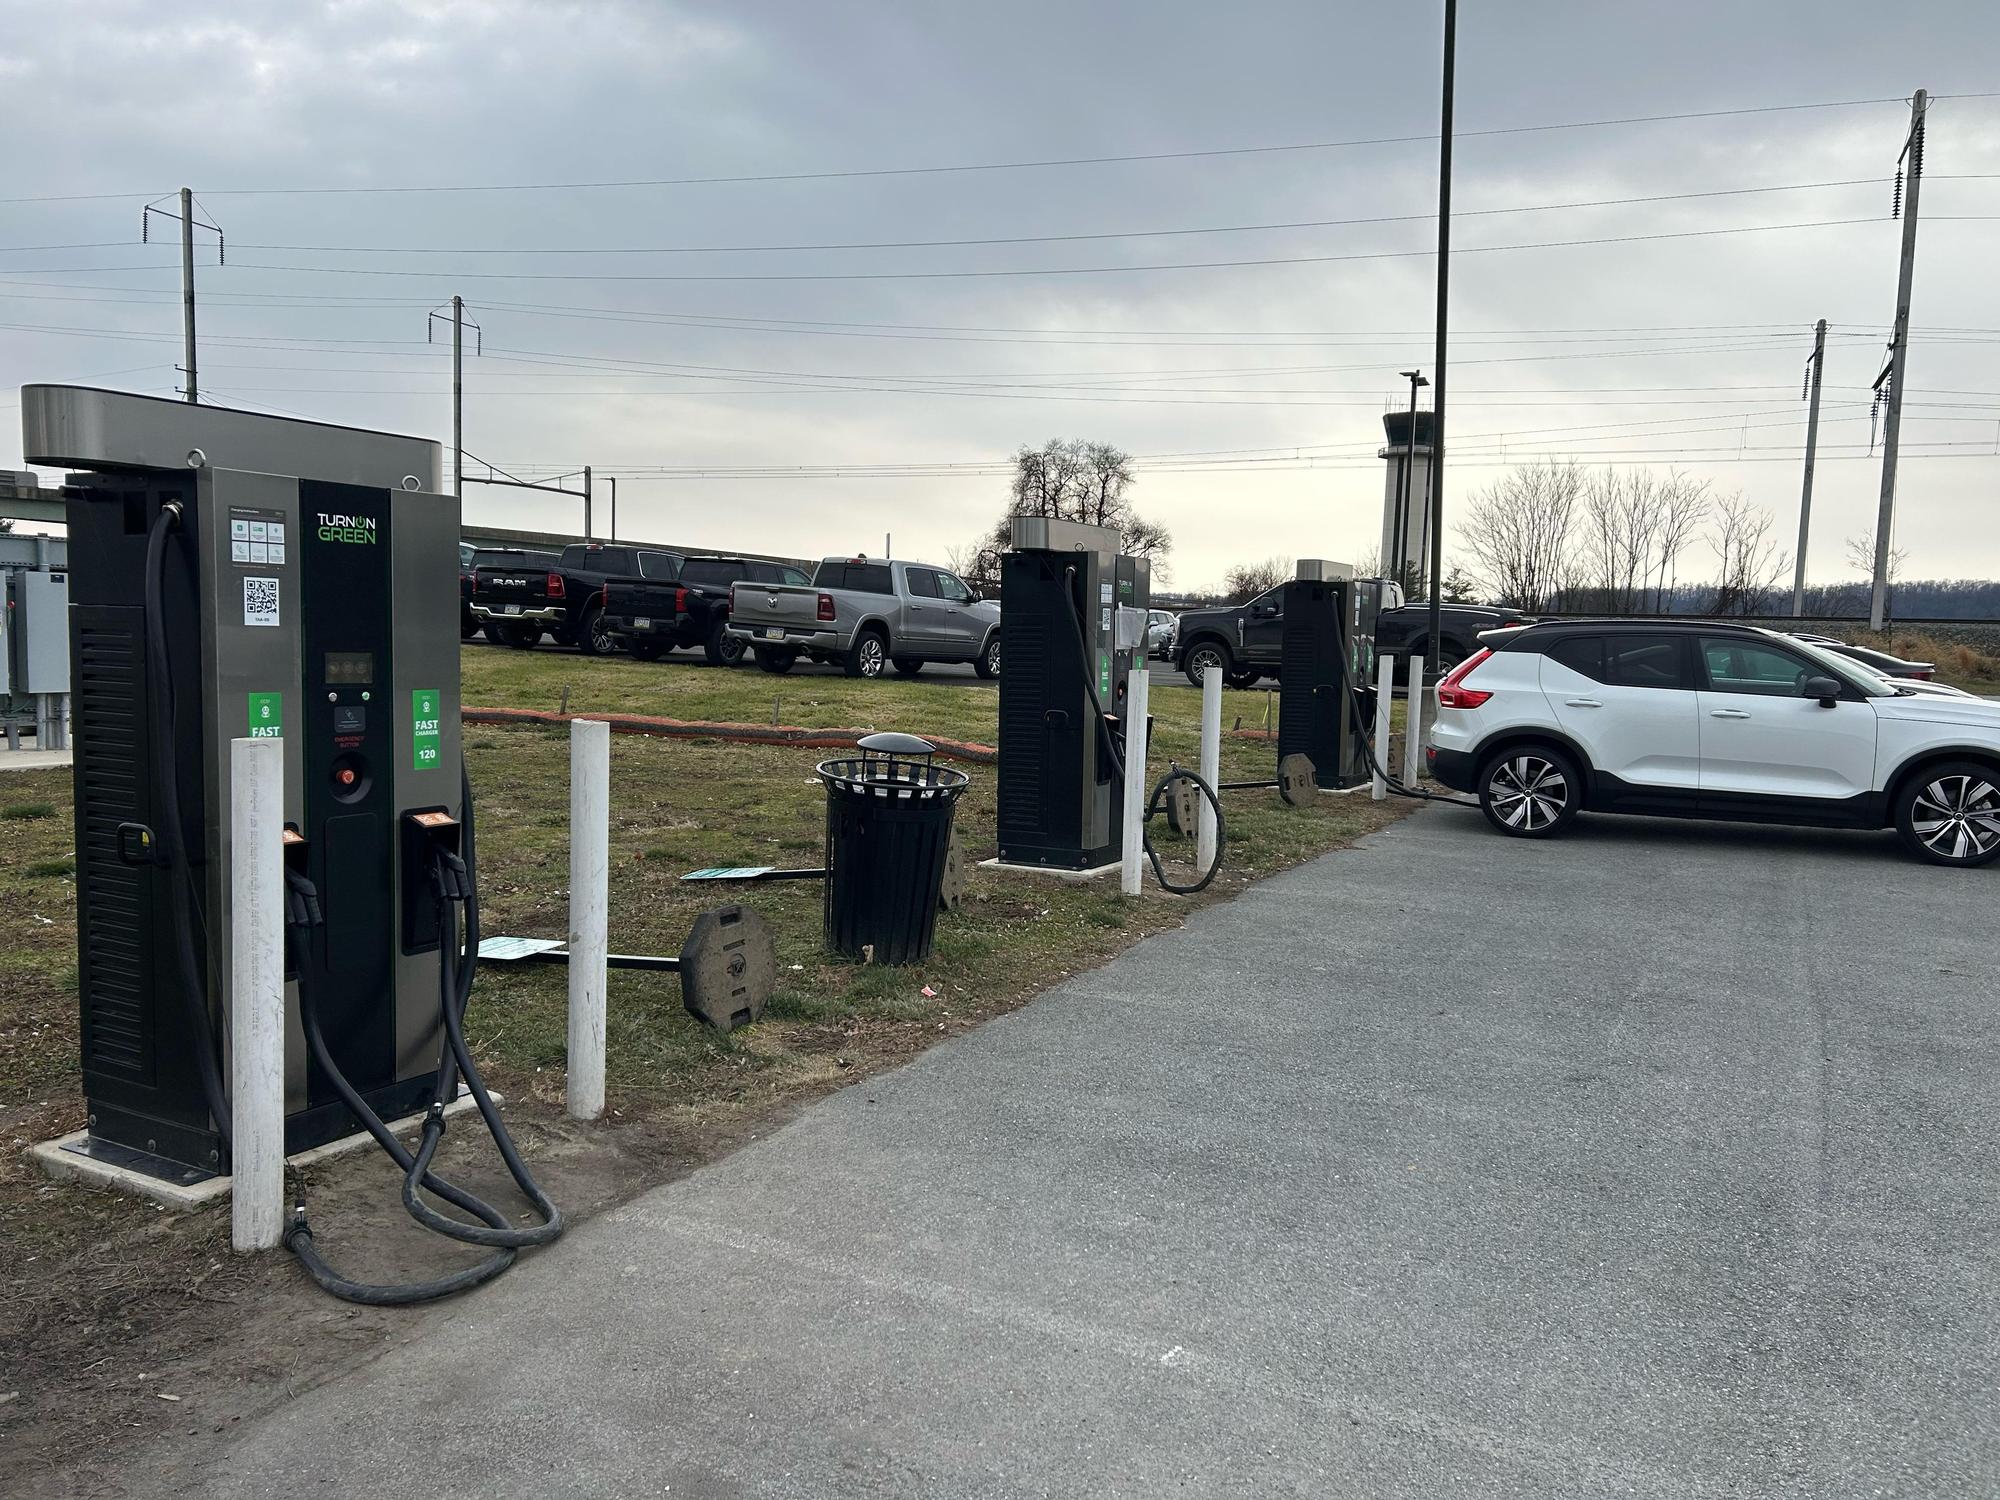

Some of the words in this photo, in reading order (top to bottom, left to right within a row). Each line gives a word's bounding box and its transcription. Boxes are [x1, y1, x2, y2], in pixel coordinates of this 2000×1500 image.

[318, 526, 376, 544] GREEN
[493, 578, 527, 586] RAM
[415, 720, 438, 730] FAST
[252, 726, 280, 737] FAST
[419, 749, 436, 759] 120
